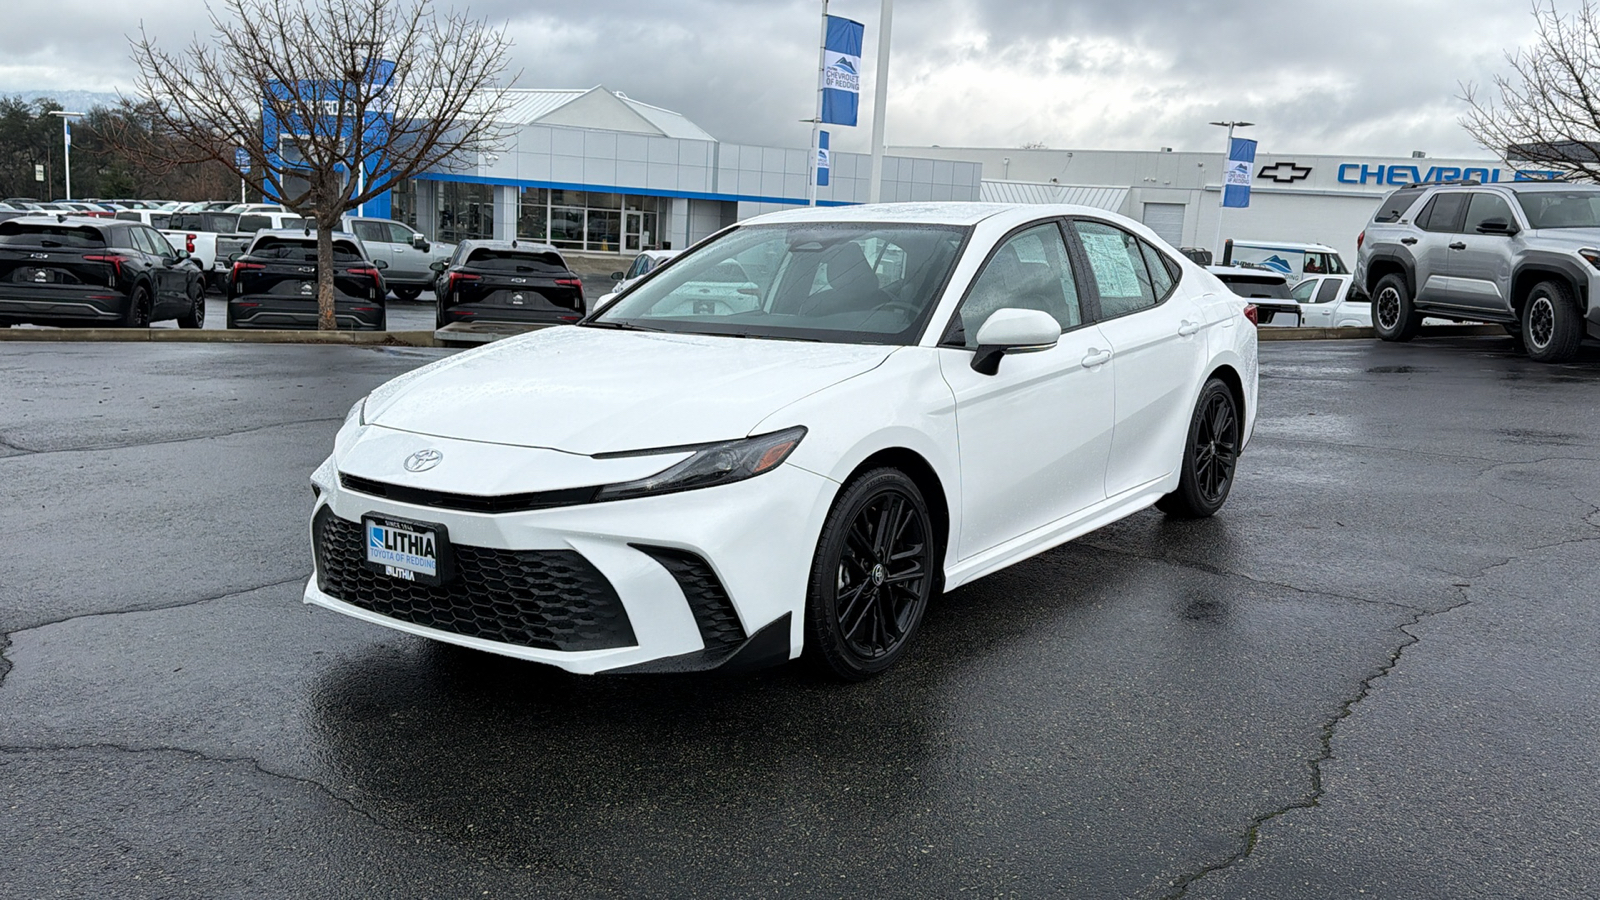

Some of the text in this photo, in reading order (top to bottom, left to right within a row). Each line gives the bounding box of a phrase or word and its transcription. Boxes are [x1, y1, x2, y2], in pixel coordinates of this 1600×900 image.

[826, 70, 859, 83] CHEVROLET
[826, 77, 859, 91] OF REDDING
[385, 520, 400, 528] SINCE
[385, 529, 436, 559] LITHIA
[370, 548, 437, 569] TOYOTA OF REDDING
[392, 566, 416, 582] LITHIA
